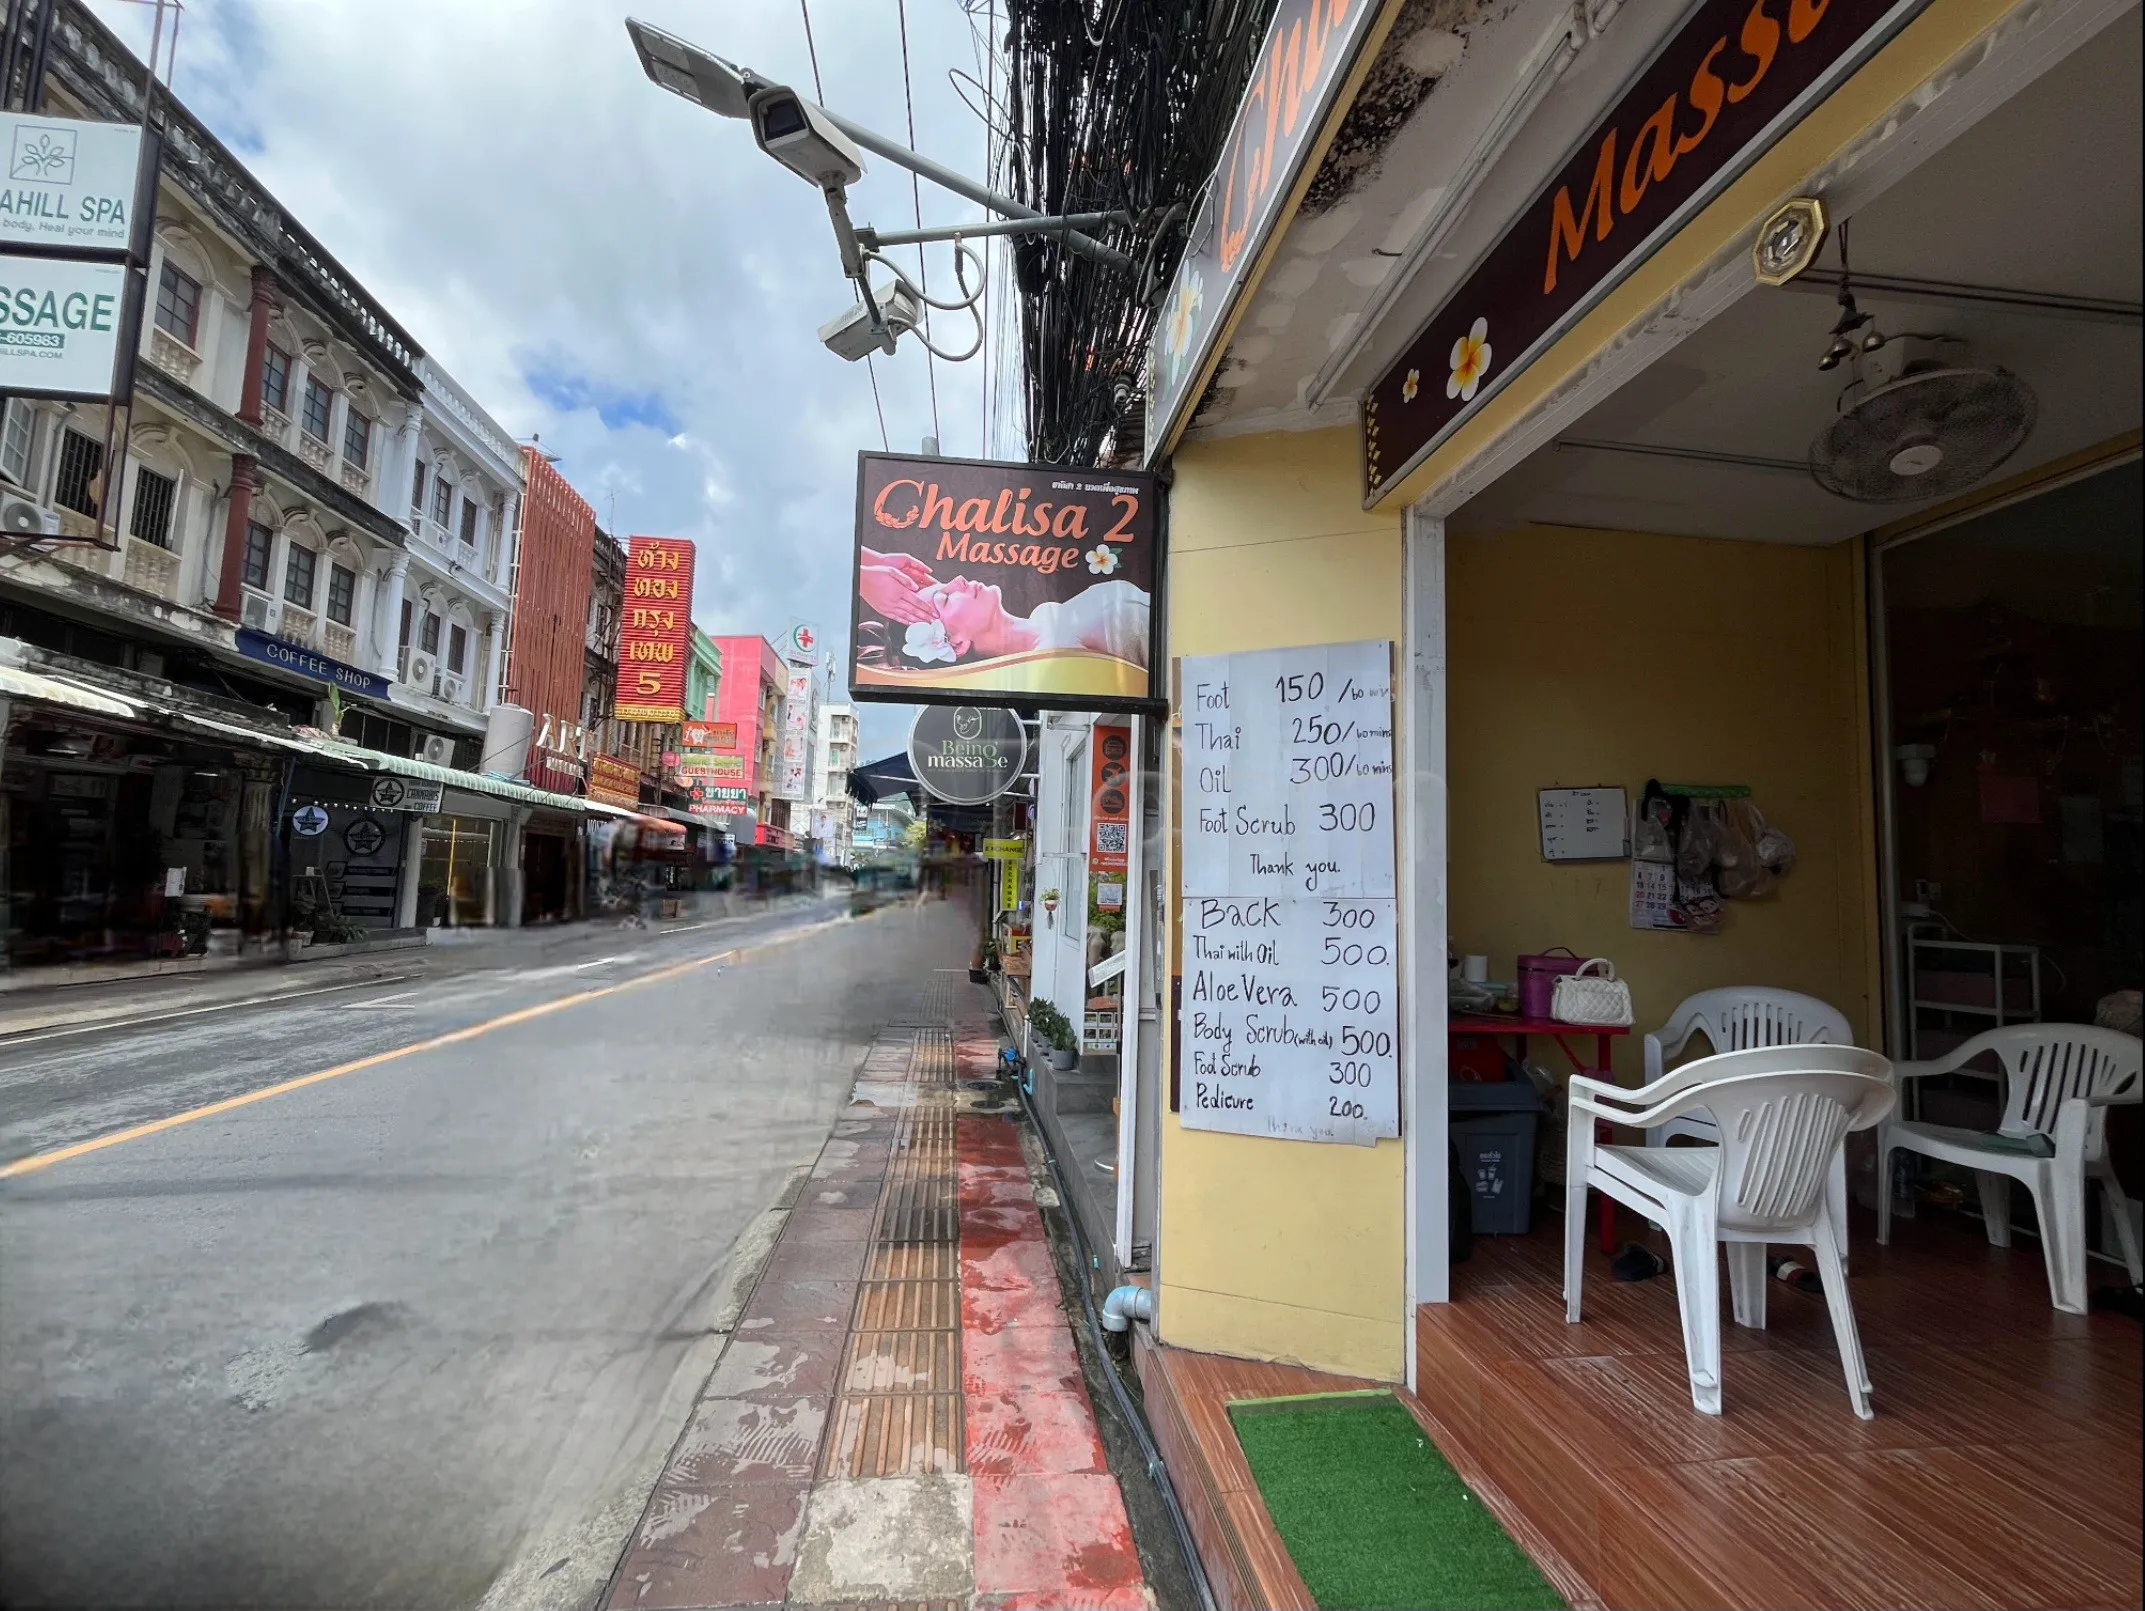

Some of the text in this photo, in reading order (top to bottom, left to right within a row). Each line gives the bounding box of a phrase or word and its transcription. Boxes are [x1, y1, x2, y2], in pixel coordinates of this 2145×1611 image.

[0, 189, 126, 225] AHILL SPA
[38, 221, 65, 233] Heal
[68, 225, 95, 237] your
[97, 228, 126, 239] mind
[0, 331, 61, 348] -605983
[873, 478, 1140, 544] Chalisa 2
[936, 531, 1080, 574] Massage
[266, 643, 371, 689] COFFEE SHOP
[636, 671, 662, 696] 5
[1196, 681, 1230, 713] Foot
[1275, 671, 1324, 704] 150
[1195, 722, 1242, 751] Thai
[704, 787, 747, 800] ขายยา
[1199, 766, 1232, 794] Oil
[414, 802, 439, 812] COFFEE
[688, 803, 746, 815] PHARMACY
[1199, 802, 1376, 836] Foot Scrub 300
[1250, 852, 1341, 892] Thank you.
[1658, 883, 1667, 891] 15
[1647, 892, 1655, 900] 21
[1657, 893, 1667, 901] 22
[1201, 897, 1376, 930] Back 300
[1192, 935, 1226, 960] Thai
[1227, 940, 1254, 963] with
[1257, 939, 1280, 966] Oil
[1192, 970, 1382, 1015] Aloe Vera 500
[1193, 1012, 1233, 1053] Body
[1246, 1014, 1295, 1045] Scrub
[1221, 1052, 1262, 1079] Scrub
[1328, 1061, 1372, 1088] 300
[1196, 1082, 1254, 1111] Pedicure
